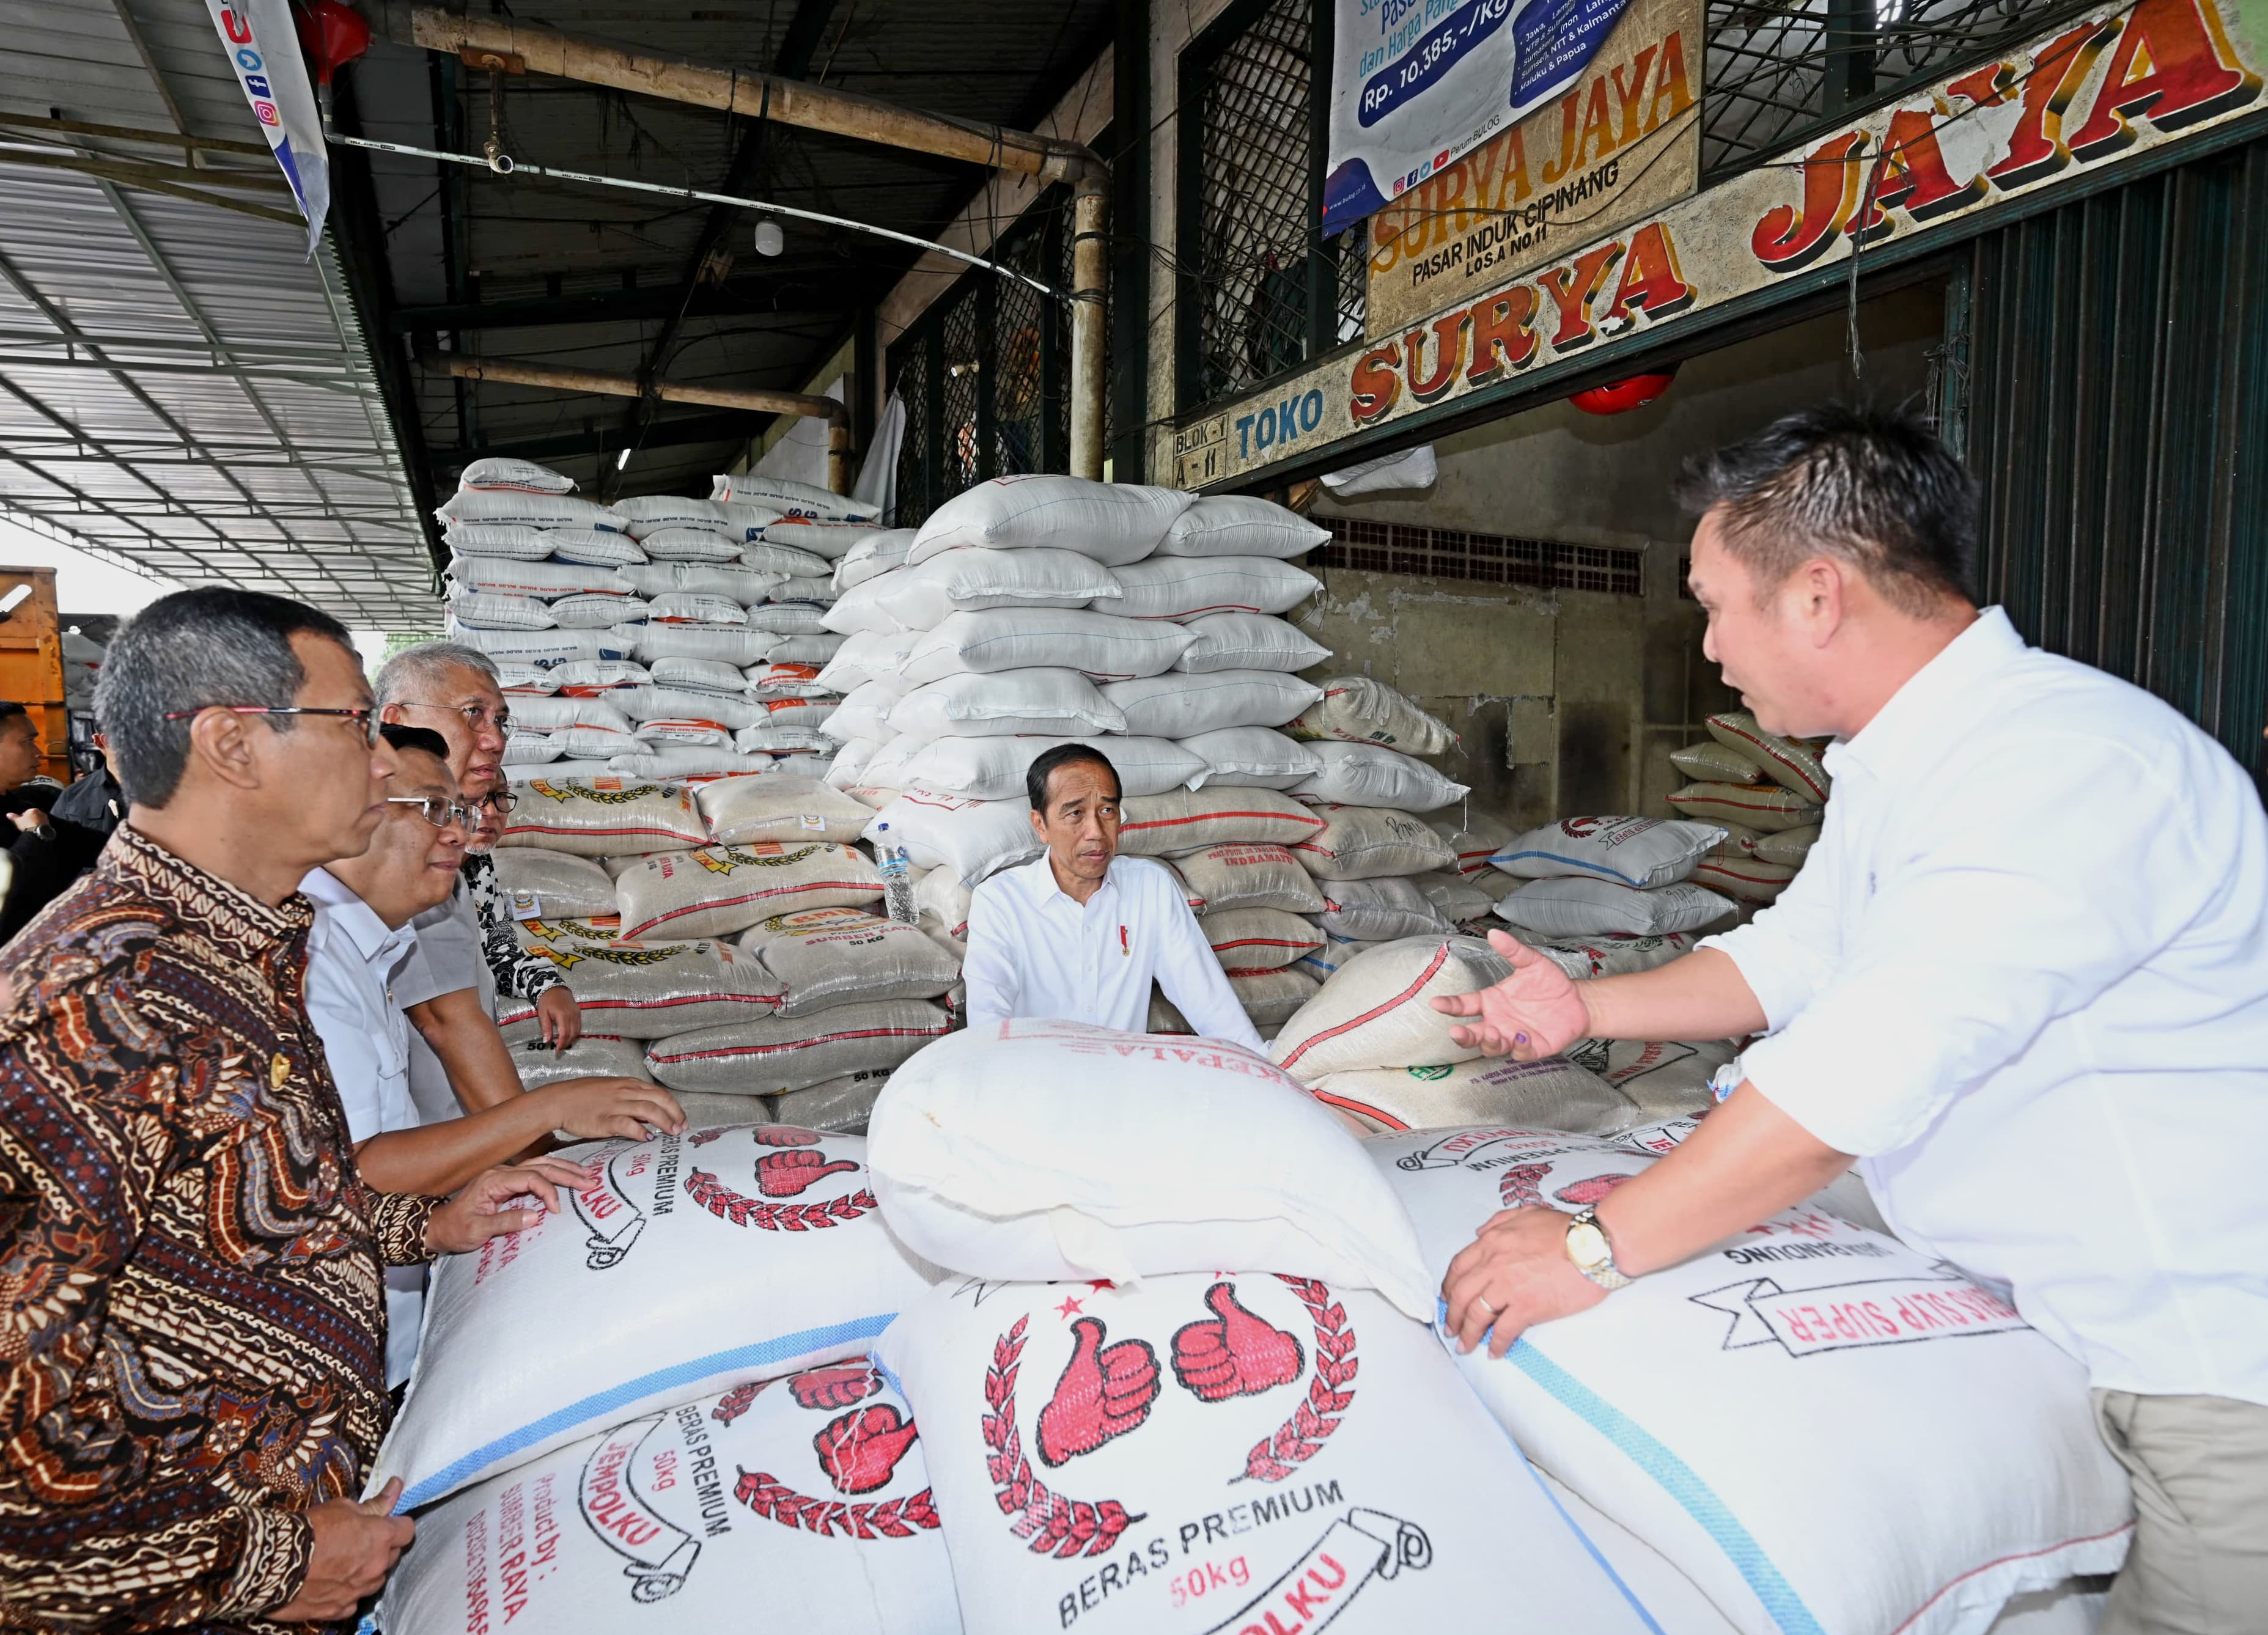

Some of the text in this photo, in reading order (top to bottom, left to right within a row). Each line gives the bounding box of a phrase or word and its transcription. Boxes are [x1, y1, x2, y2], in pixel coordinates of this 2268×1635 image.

[1525, 23, 1547, 42] Jawa,
[1551, 36, 1566, 54] NTT
[1569, 32, 1575, 41] &
[1560, 14, 1578, 34] (non
[1360, 46, 1383, 79] dan
[1388, 13, 1421, 60] Harga
[1520, 42, 1586, 92] Maluku & Papua
[1364, 84, 1393, 114] Rp.
[1370, 30, 1694, 279] SURYA JAYA
[1450, 114, 1500, 157] Perum BULOG
[1350, 0, 2264, 427] SURYA JAYA
[1413, 160, 1619, 286] PASAR INDUK CIPINANG
[1176, 424, 1208, 455] BLOK
[1236, 388, 1324, 459] TOKO
[1176, 459, 1185, 487] A
[1224, 850, 1294, 866] INDRAMAYU
[804, 925, 918, 946] SUMBER RAYA
[831, 927, 868, 936] Product
[867, 936, 885, 944] KG
[527, 1042, 545, 1051] 50
[1112, 1042, 1285, 1087] KEPALA
[853, 1068, 891, 1082] 50 KG
[625, 1153, 651, 1177] 50kg
[1465, 1148, 1564, 1172] PREMIUM
[1504, 1139, 1558, 1150] 50kg
[652, 1156, 679, 1216] PREMIUM
[1723, 1241, 1851, 1265] BANDUNG
[1778, 1300, 1901, 1343] SUPER
[1893, 1292, 1967, 1332] SLYP
[651, 1449, 679, 1493] 50kg
[675, 1405, 732, 1539] BERAS PREMIUM
[532, 1472, 558, 1543] Product
[587, 1441, 662, 1546] JEMPOLKU
[499, 1482, 529, 1626] SUMBER RAYA
[1058, 1479, 1344, 1629] BERAS PREMIUM
[1168, 1555, 1251, 1609] 50kg
